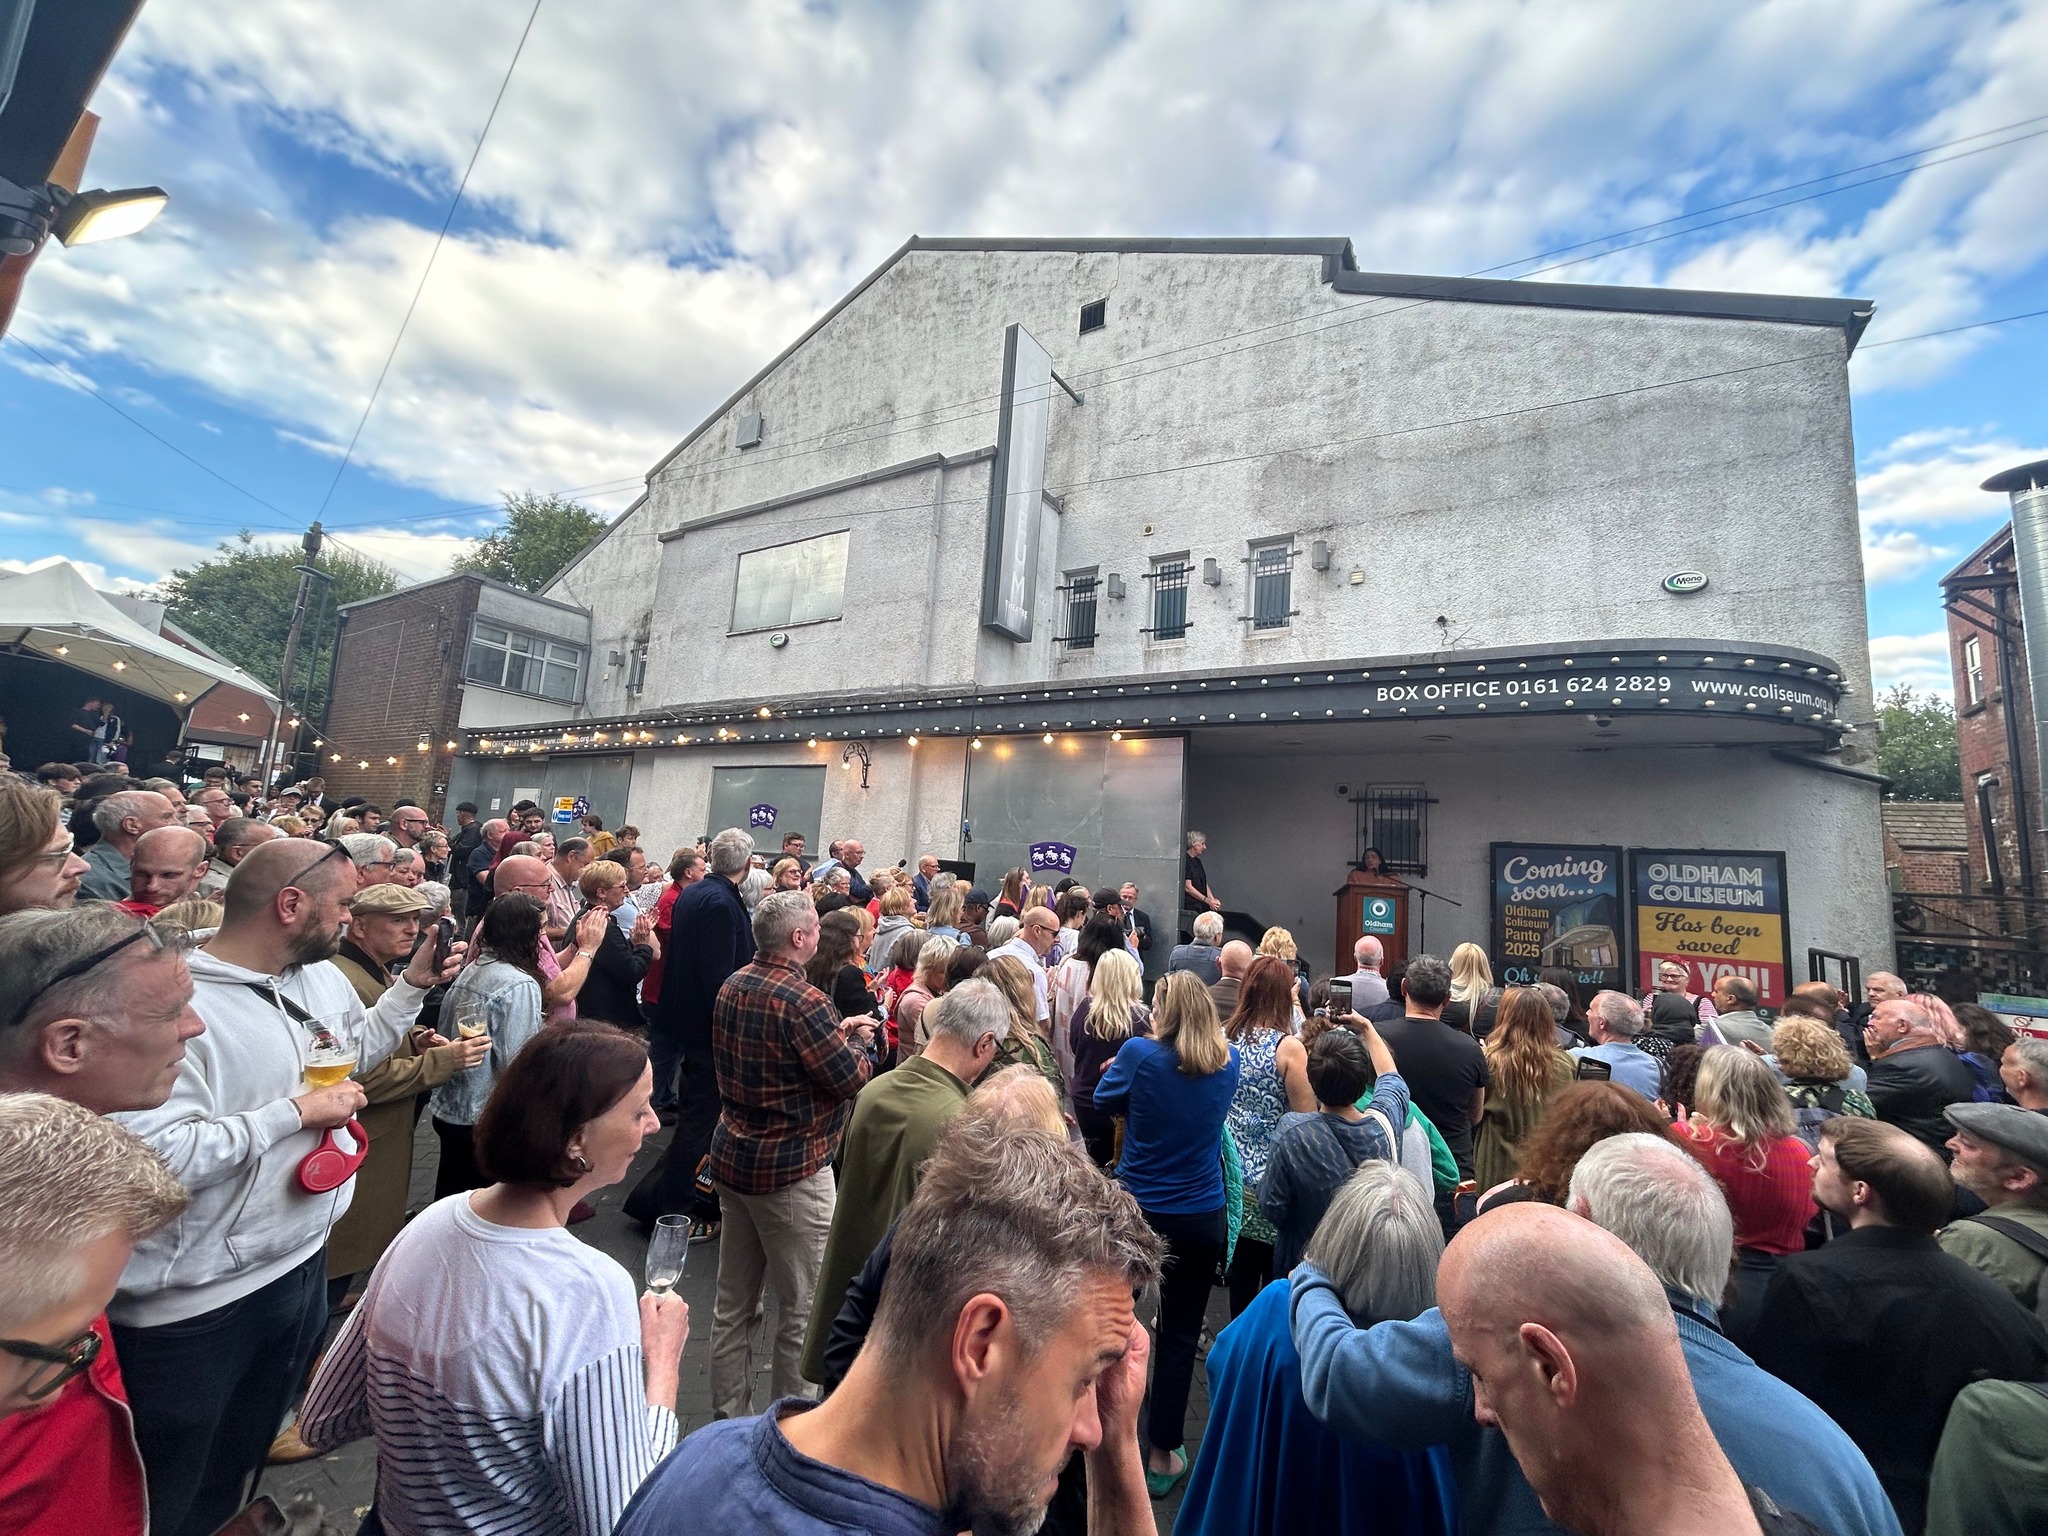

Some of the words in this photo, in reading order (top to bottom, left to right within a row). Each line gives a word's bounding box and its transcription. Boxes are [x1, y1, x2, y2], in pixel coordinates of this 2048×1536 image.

[1675, 576, 1703, 585] Mono
[1376, 685, 1419, 701] BOX
[1423, 681, 1500, 699] OFFICE
[1506, 678, 1559, 695] 0161
[1566, 677, 1608, 692] 624
[1615, 676, 1671, 692] 2829
[1503, 856, 1608, 884] Coming
[1648, 863, 1763, 887] OLDHAM
[1510, 883, 1594, 902] soon...
[1648, 884, 1764, 907] COLISEUM
[1505, 904, 1549, 918] Oldham
[1364, 920, 1394, 929] Oldham
[1505, 916, 1550, 929] Coliseum
[1655, 911, 1707, 933] Has
[1711, 915, 1762, 938] been
[1505, 928, 1541, 942] Panto
[1505, 942, 1540, 957] 2025
[1676, 936, 1742, 956] saved
[1503, 966, 1531, 984] Oh
[1578, 970, 1605, 984] is!!
